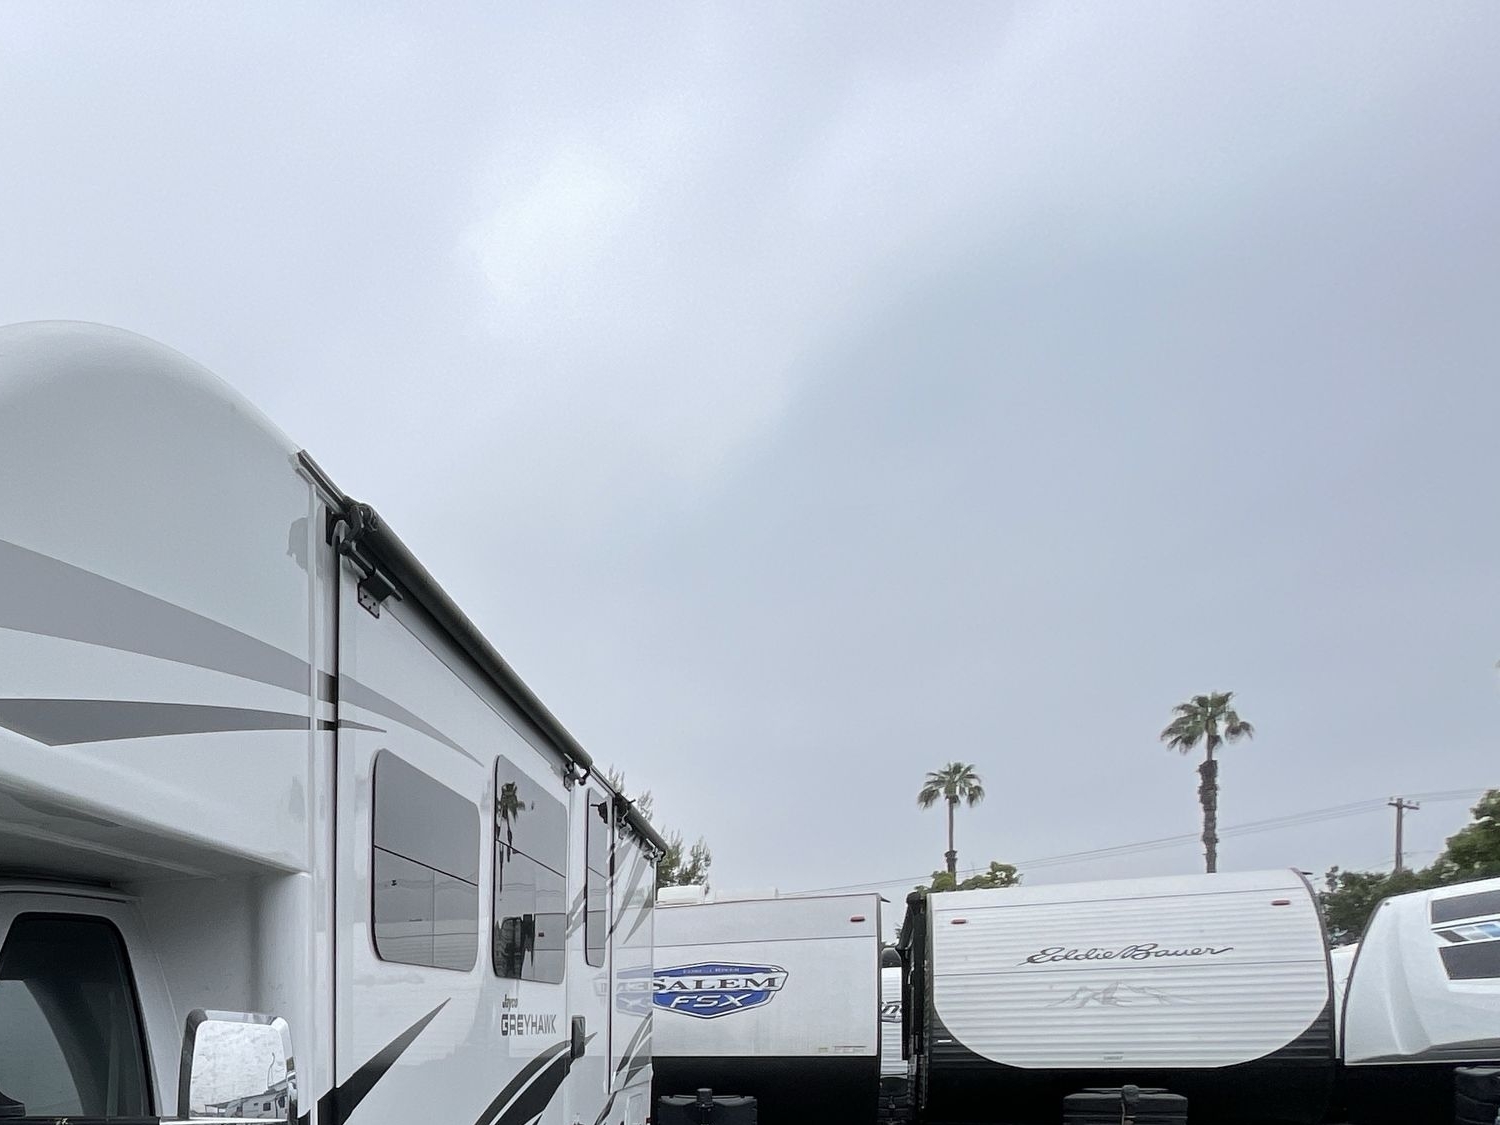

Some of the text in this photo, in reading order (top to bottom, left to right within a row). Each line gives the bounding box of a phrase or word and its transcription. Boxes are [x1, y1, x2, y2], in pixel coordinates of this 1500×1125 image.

[1015, 943, 1234, 966] Eddie Bauer
[652, 978, 778, 991] SALEM
[670, 993, 752, 1007] FSX
[501, 1013, 557, 1036] GREYHAWK
